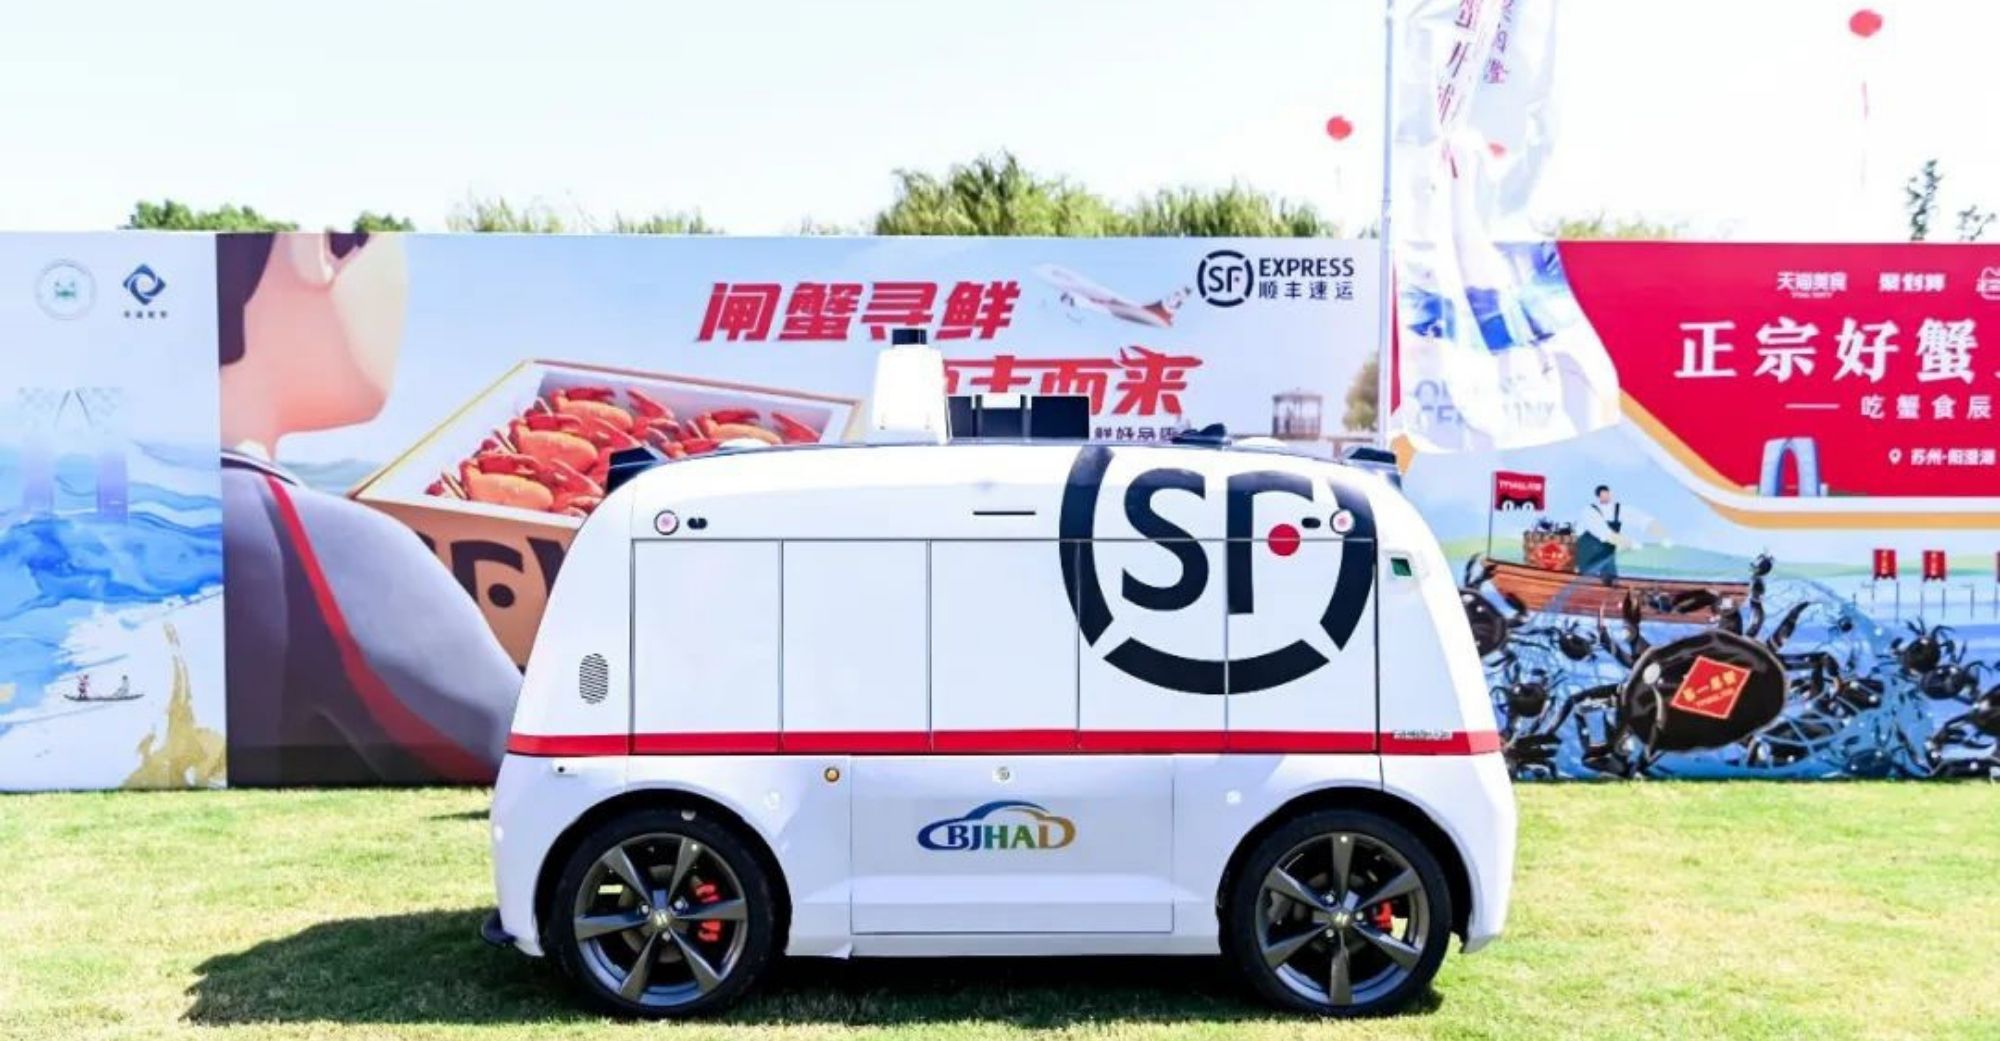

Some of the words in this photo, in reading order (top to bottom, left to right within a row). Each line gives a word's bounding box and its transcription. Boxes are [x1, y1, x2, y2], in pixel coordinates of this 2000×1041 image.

[1259, 258, 1355, 277] EXPRESS
[1258, 281, 1354, 300] 顺丰速运
[697, 281, 1020, 341] 闸蟹寻鲜
[1674, 316, 2000, 384] 正宗好蟹
